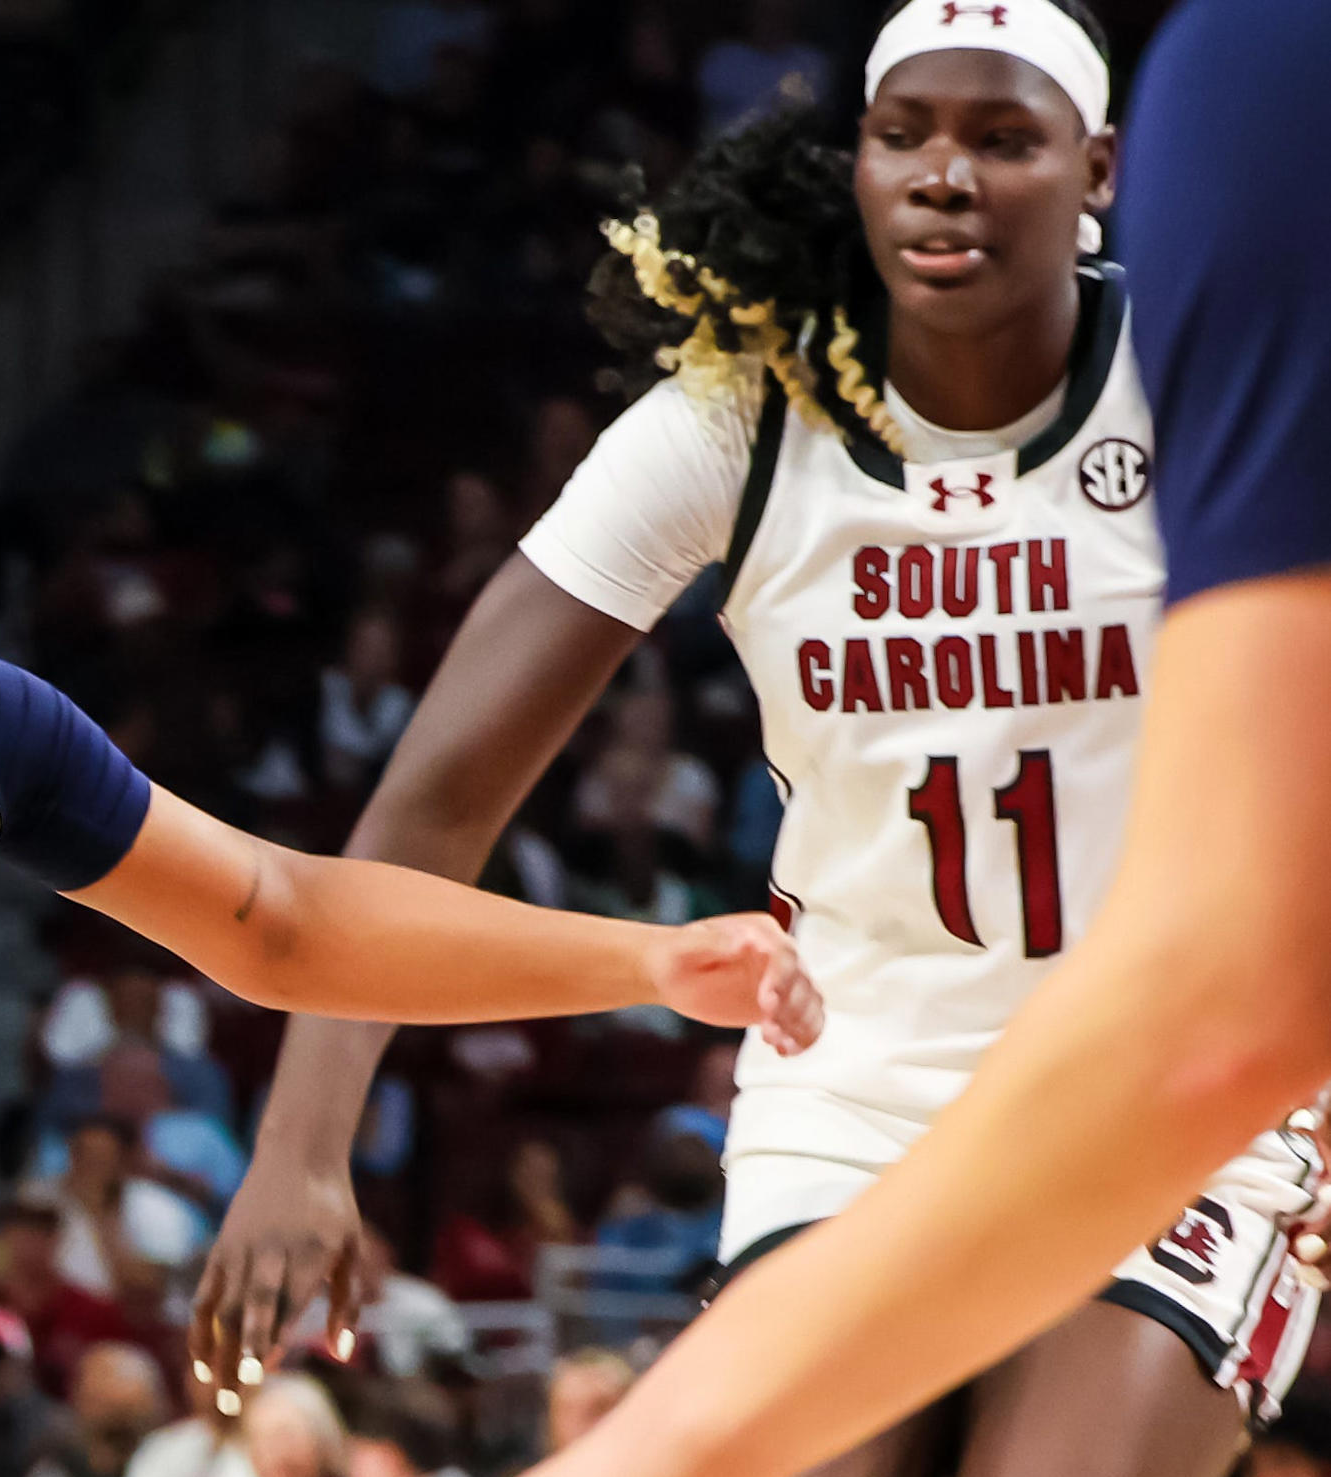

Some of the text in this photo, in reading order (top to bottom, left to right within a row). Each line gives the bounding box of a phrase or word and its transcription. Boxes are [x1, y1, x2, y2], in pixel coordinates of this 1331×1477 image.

[1081, 441, 1147, 506] SEC
[851, 537, 1070, 621] SOUTH
[796, 624, 1140, 714] CAROLINA
[907, 749, 1063, 959] 11
